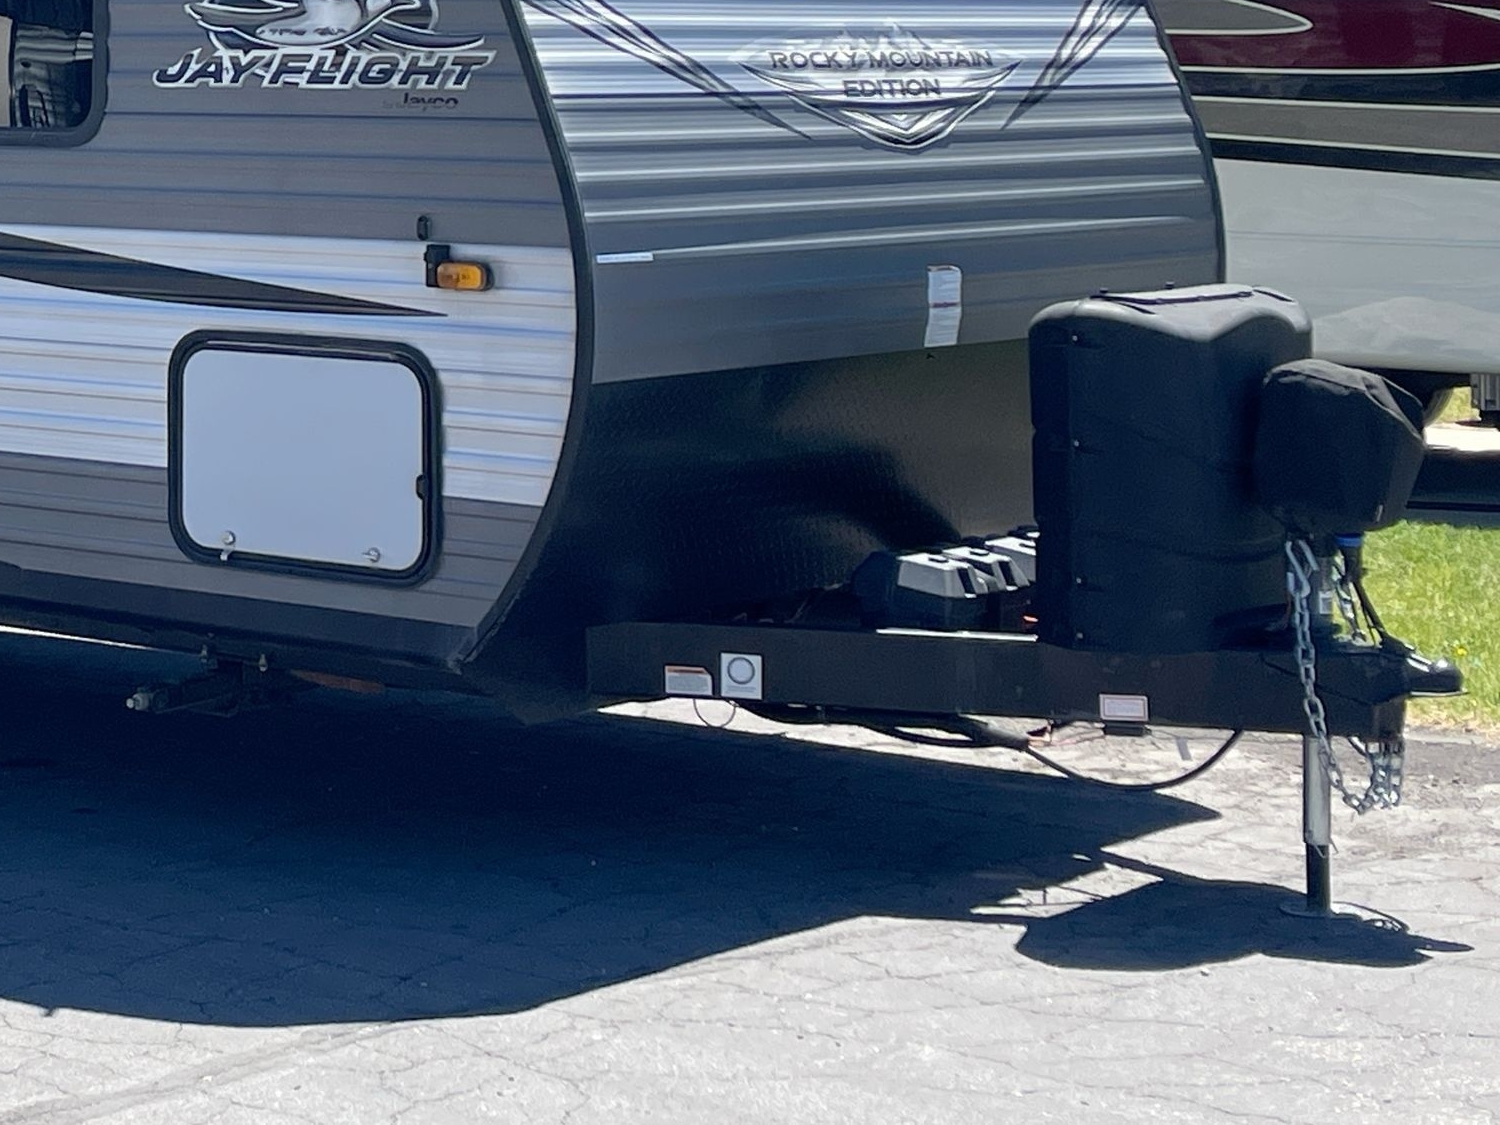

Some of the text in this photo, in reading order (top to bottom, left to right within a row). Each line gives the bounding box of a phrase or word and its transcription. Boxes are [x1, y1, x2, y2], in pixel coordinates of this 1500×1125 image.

[152, 49, 495, 89] JAY FLIGHT
[769, 50, 994, 69] ROCKY MOUNTAIN
[843, 79, 942, 98] EDITION
